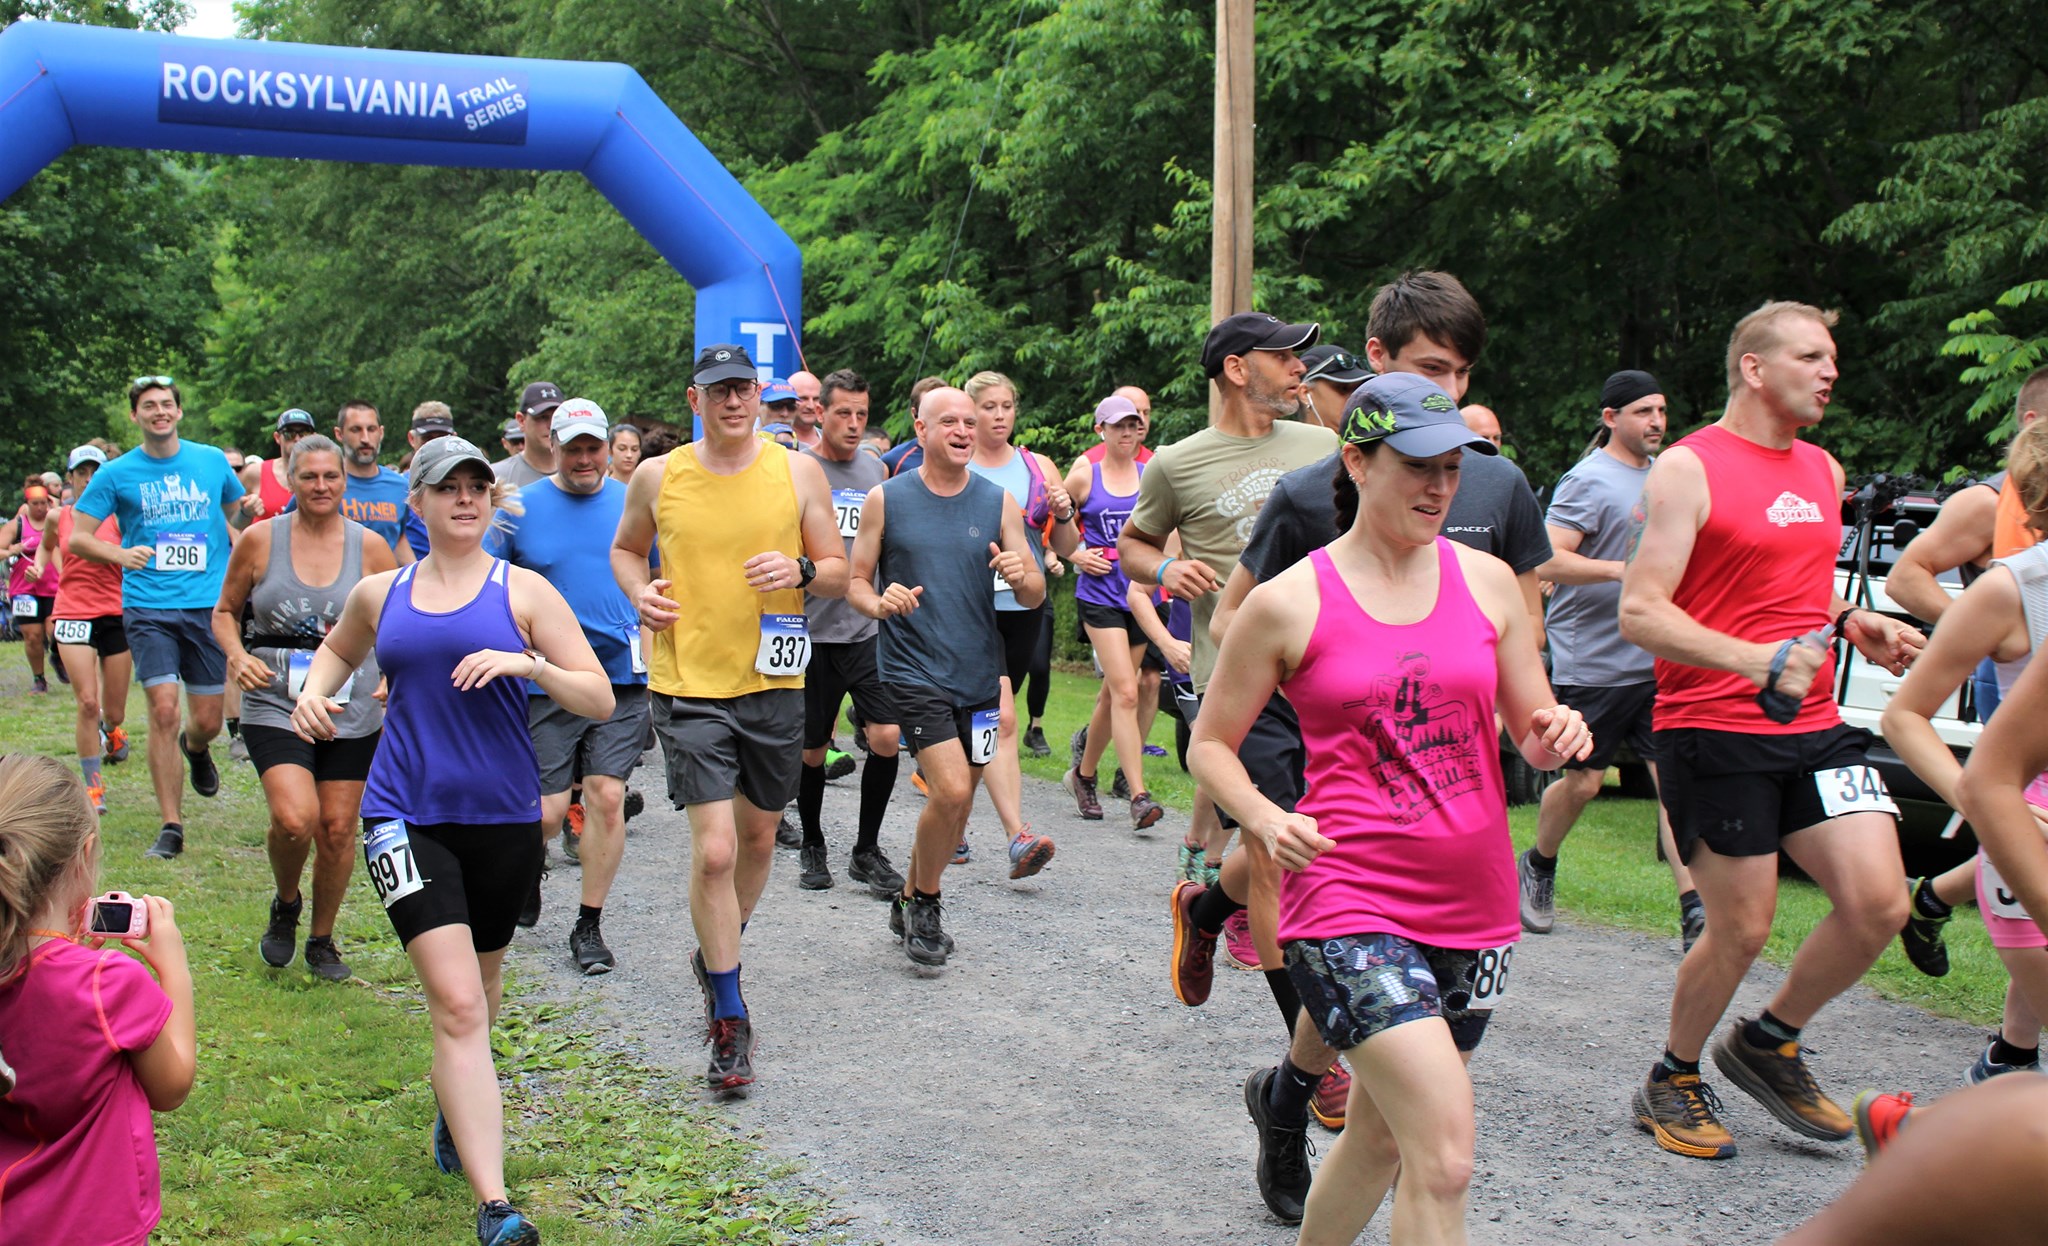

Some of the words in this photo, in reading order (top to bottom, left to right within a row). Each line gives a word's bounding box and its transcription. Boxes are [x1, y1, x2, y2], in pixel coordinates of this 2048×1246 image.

[163, 62, 454, 119] ROCKSYLVANIA
[456, 77, 517, 109] TRAIL
[464, 93, 527, 131] SERIES
[139, 481, 162, 497] BEAT
[179, 501, 200, 522] 10K
[342, 498, 398, 520] HYNER
[836, 507, 860, 530] 76
[1446, 525, 1495, 533] SPACEX
[165, 545, 198, 565] 296
[16, 601, 31, 613] 425
[57, 621, 87, 638] 458
[770, 636, 806, 667] 337
[983, 727, 998, 756] 27
[370, 843, 414, 899] 897
